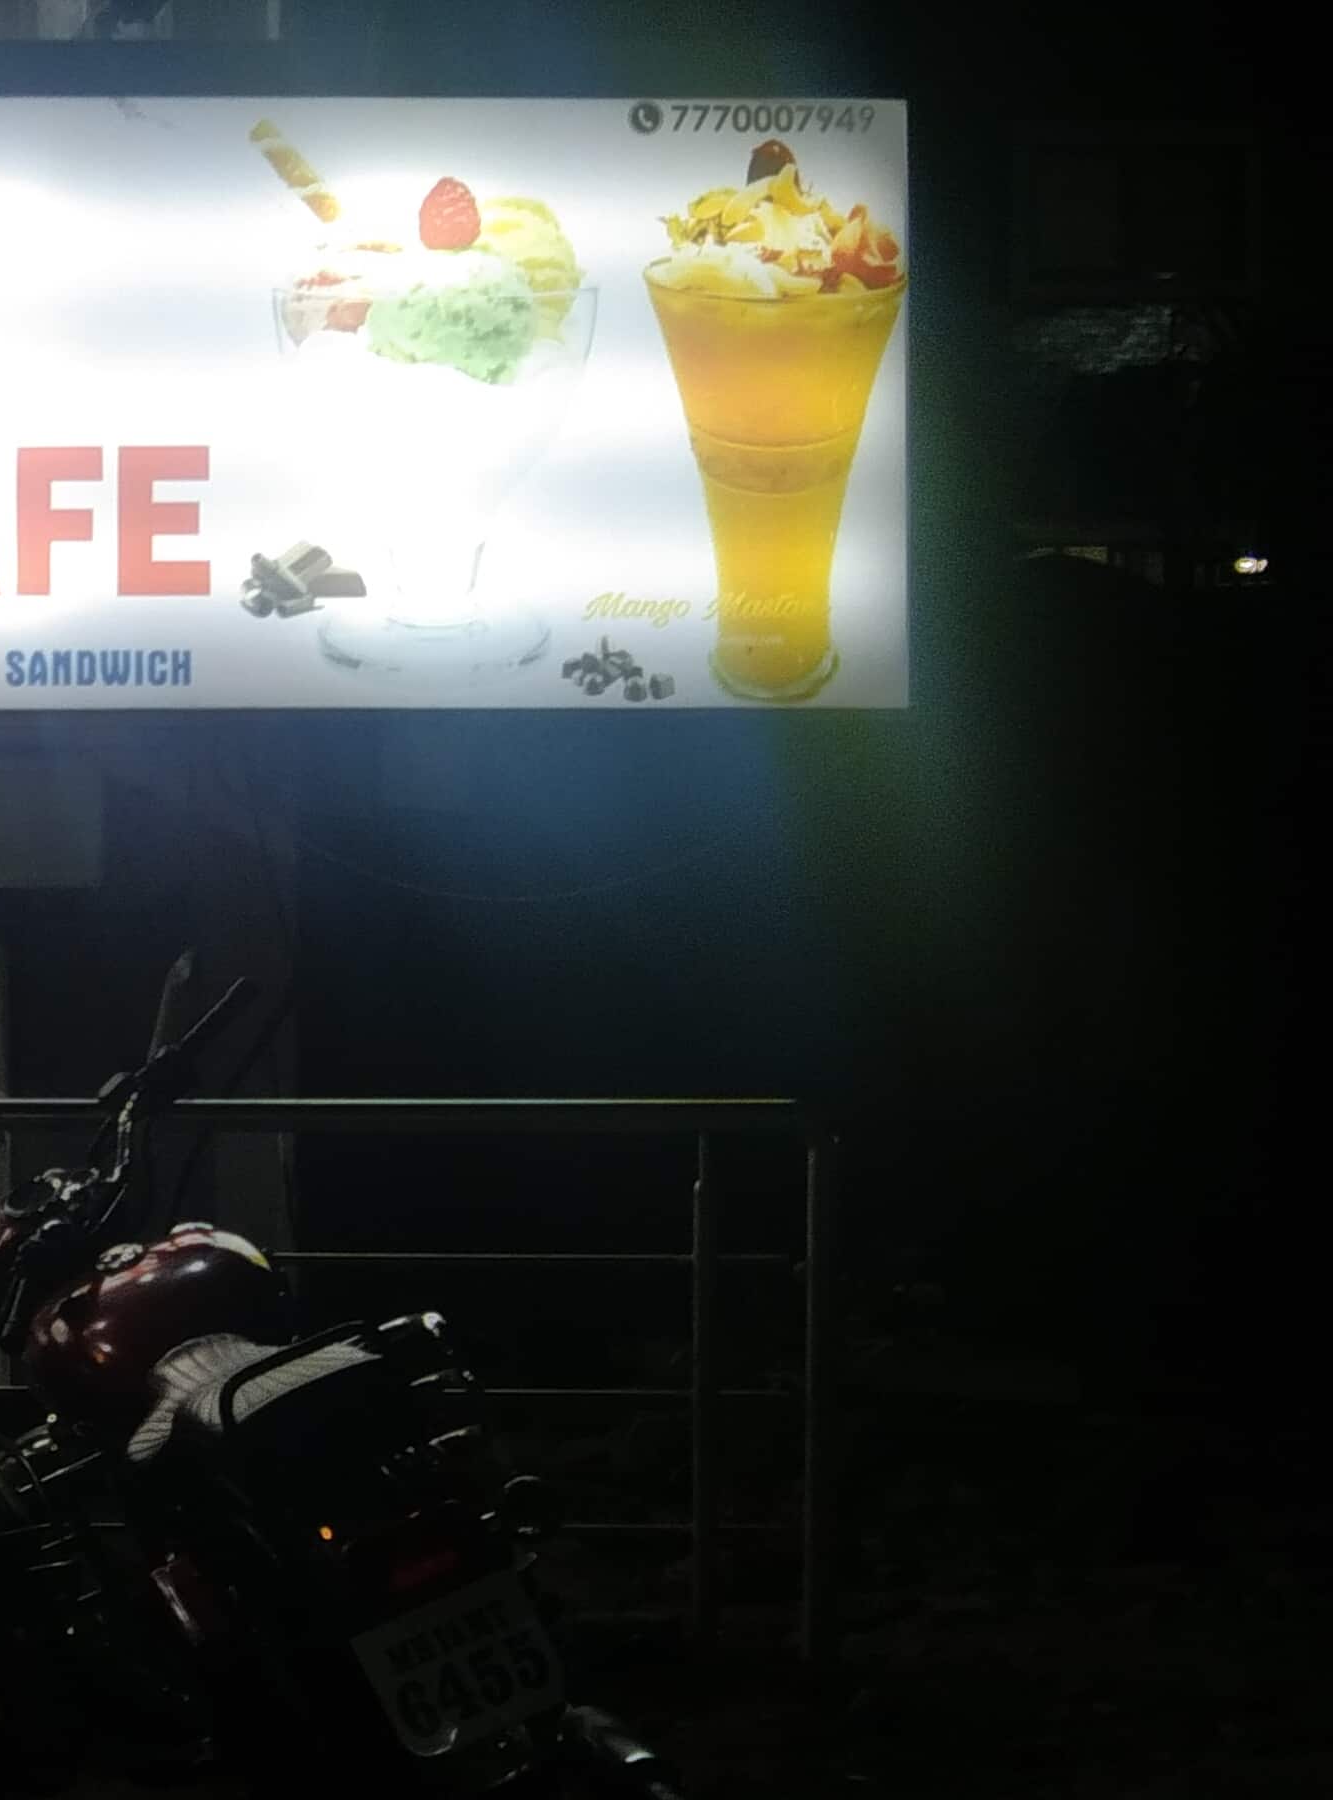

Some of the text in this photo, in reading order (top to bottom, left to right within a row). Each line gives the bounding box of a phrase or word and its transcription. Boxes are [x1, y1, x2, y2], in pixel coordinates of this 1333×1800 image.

[670, 104, 877, 133] 7770007949
[583, 591, 691, 630] Mango
[5, 649, 193, 687] SANDWICH
[396, 1629, 550, 1738] 6455
